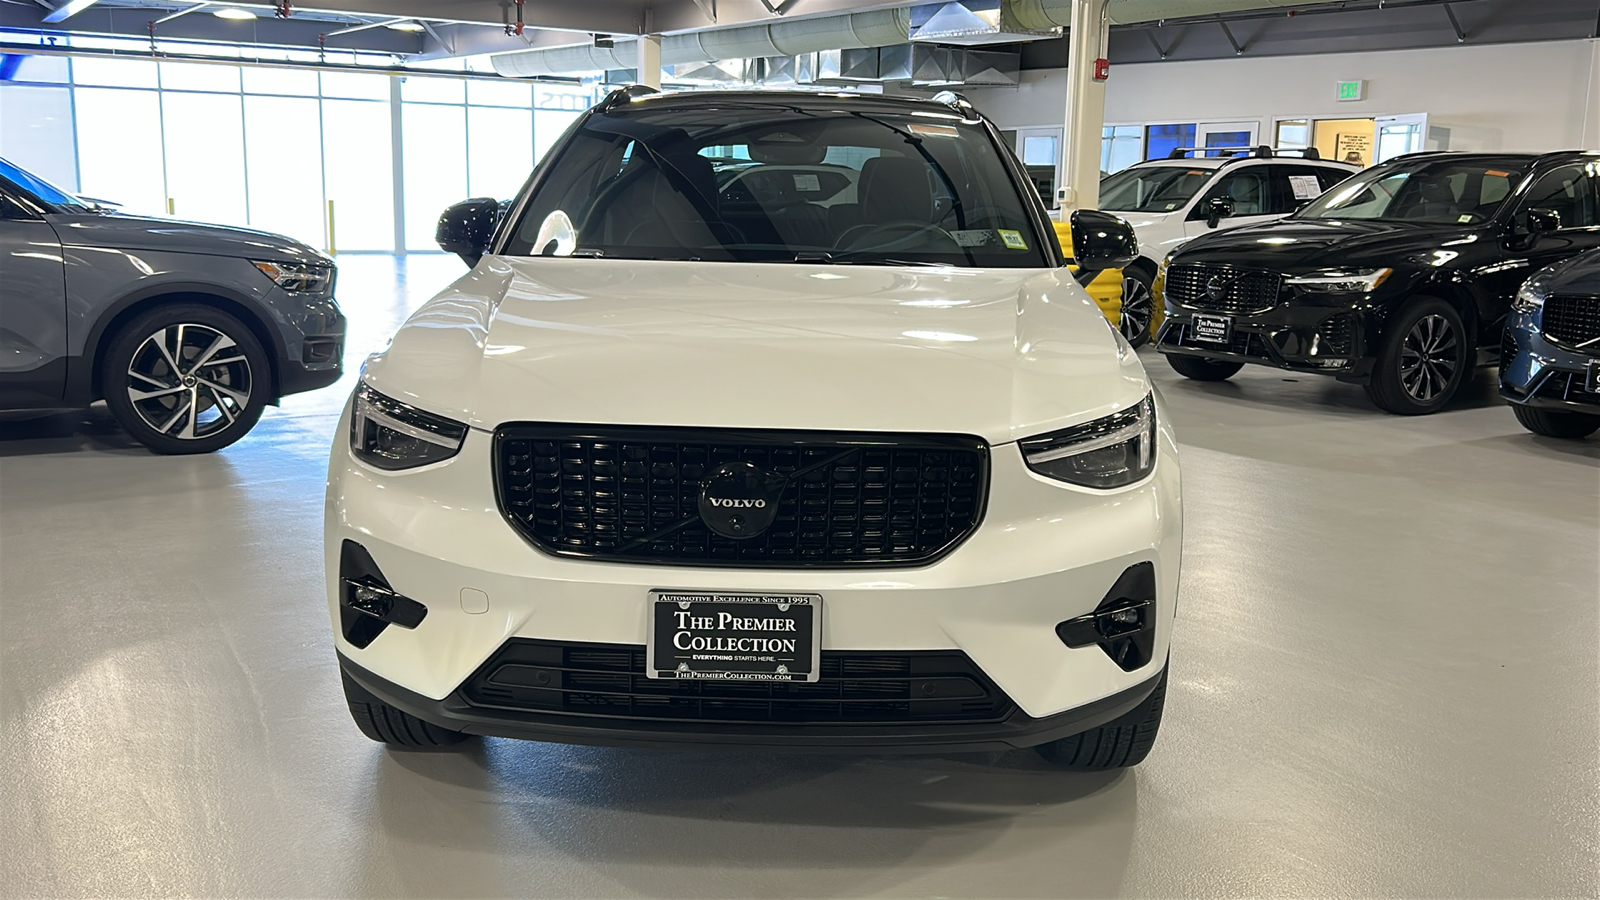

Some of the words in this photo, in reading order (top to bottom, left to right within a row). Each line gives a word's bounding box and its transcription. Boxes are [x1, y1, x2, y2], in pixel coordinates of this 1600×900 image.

[1340, 82, 1358, 99] EXIT
[709, 497, 766, 508] VOLVO
[660, 594, 712, 602] AUTOMOTIVE
[713, 595, 761, 603] EXCELLENCE
[762, 596, 786, 604] SINCE
[788, 597, 809, 605] 1995
[673, 611, 714, 630] THE
[717, 612, 797, 632] PREMIER
[673, 631, 797, 653] COLLECTION
